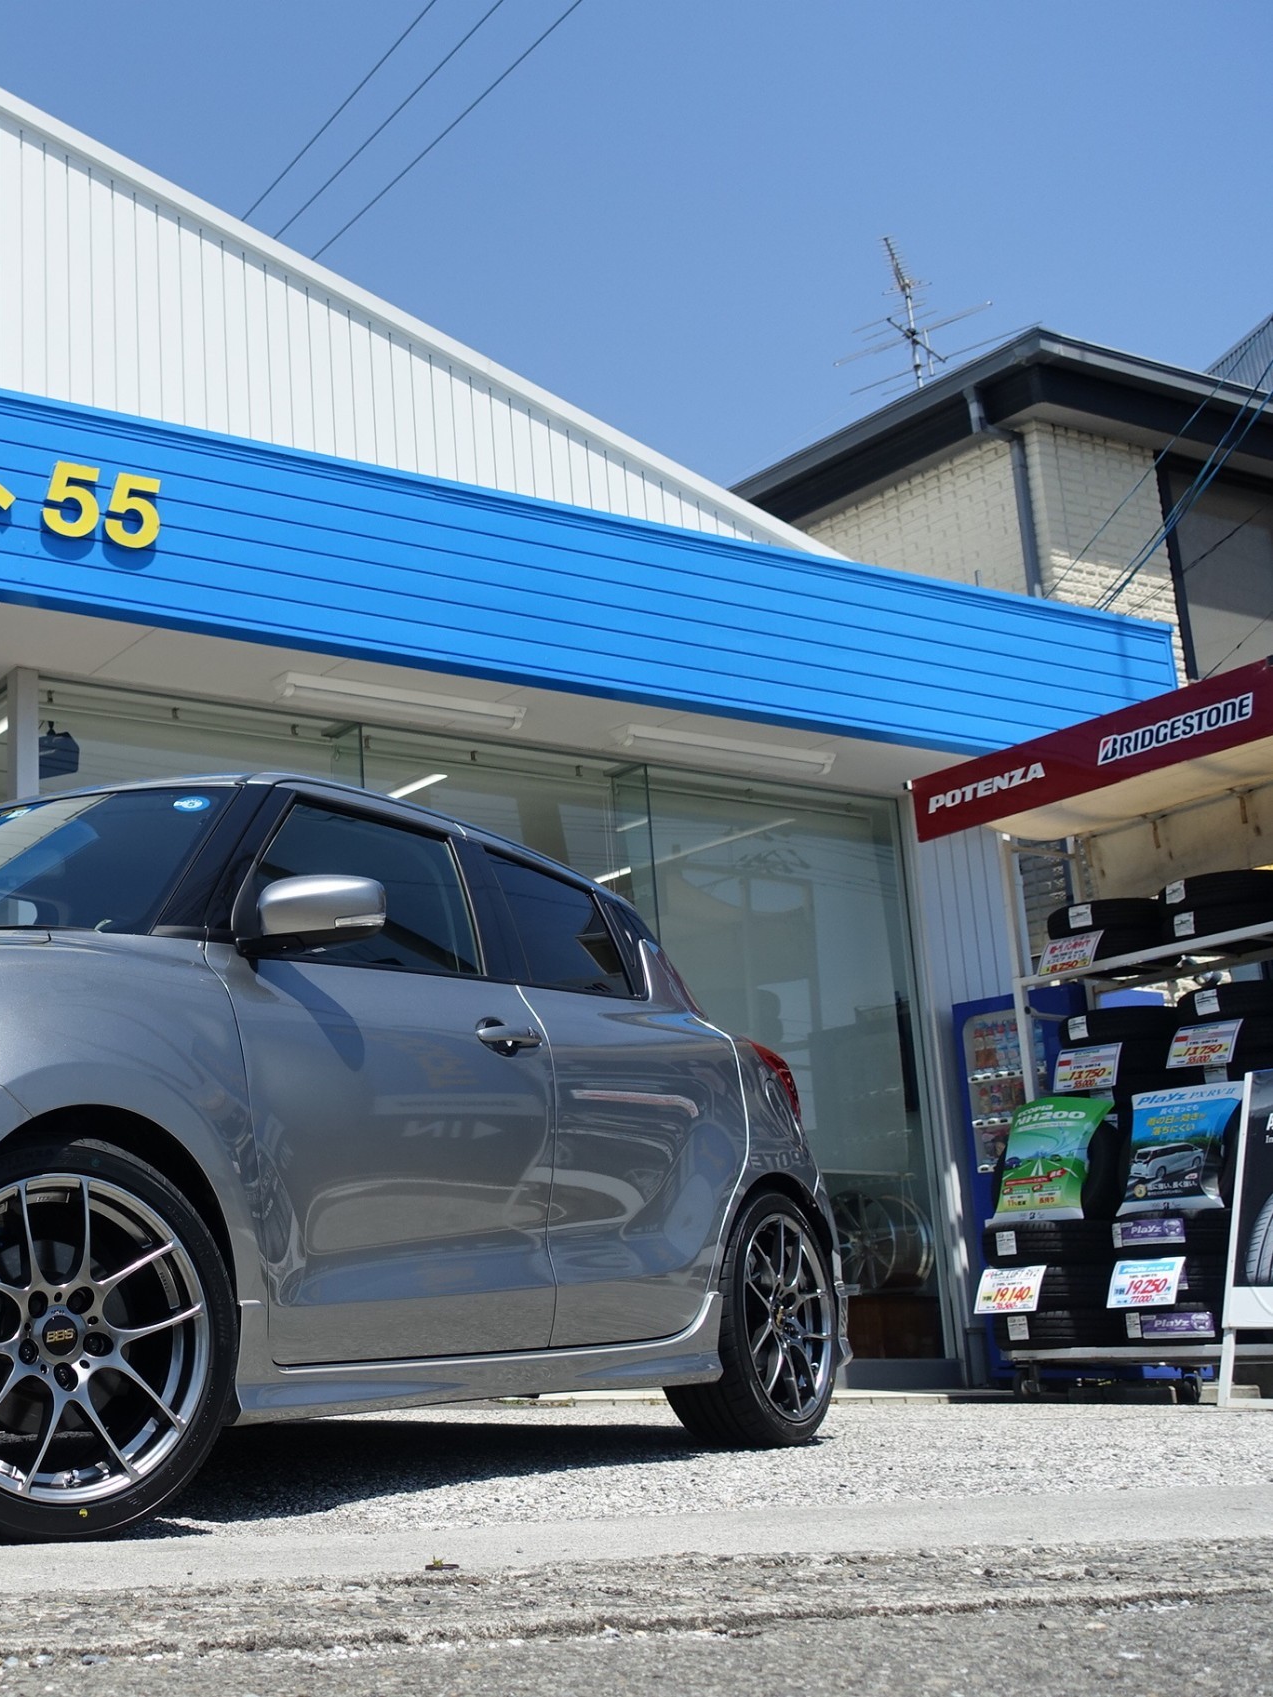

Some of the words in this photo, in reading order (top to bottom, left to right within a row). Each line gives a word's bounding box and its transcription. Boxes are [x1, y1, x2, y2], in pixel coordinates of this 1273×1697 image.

[42, 461, 162, 549] 55
[1098, 692, 1253, 765] BRIDGESTONE
[928, 763, 1045, 814] POTENZA
[1137, 1092, 1187, 1106] Playz
[1015, 1111, 1086, 1127] NH200
[1131, 1225, 1162, 1234] Playz
[1154, 1319, 1190, 1328] Playz
[46, 1328, 75, 1343] BBS
